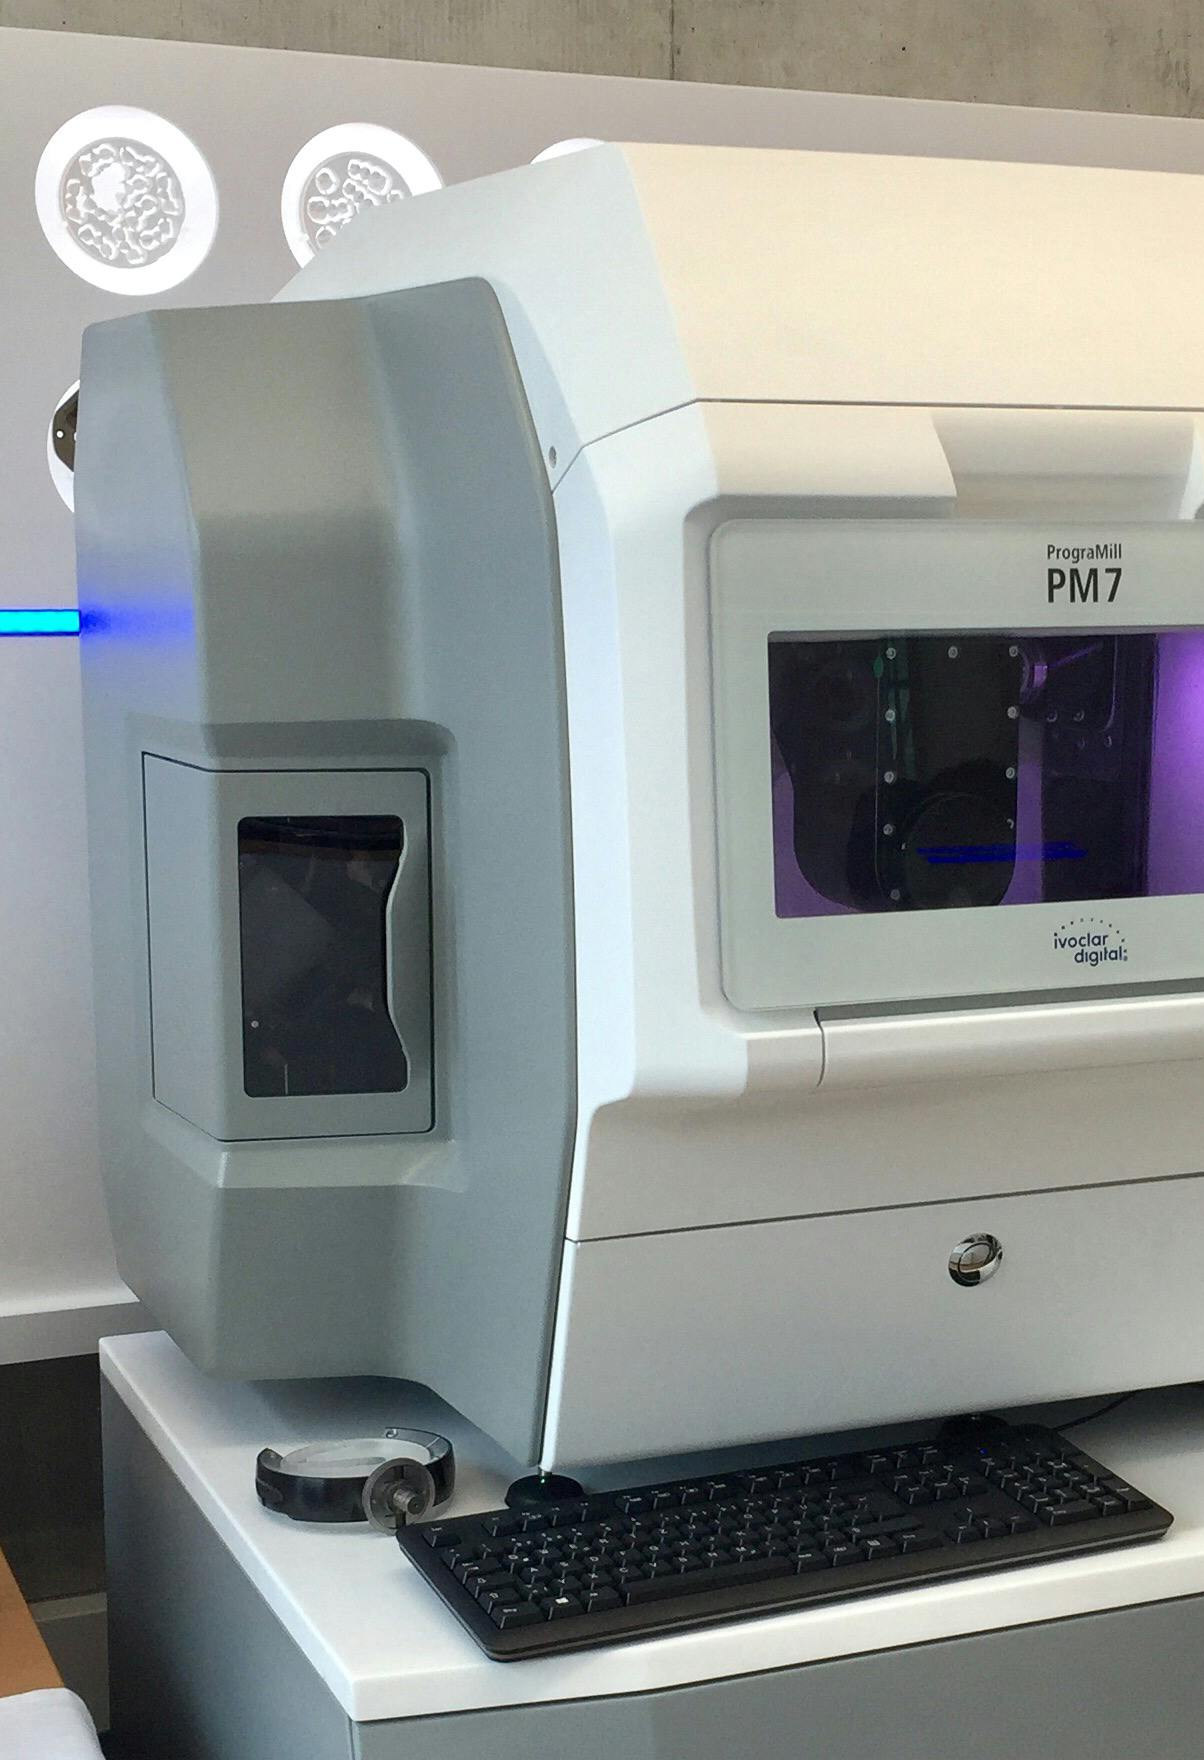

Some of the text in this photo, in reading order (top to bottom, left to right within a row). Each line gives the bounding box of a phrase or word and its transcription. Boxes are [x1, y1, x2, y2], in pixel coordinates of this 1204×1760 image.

[1047, 544, 1122, 564] PrograMill
[1047, 567, 1122, 603] PM7
[1053, 932, 1109, 949] ivoclar
[1074, 946, 1123, 967] digital
